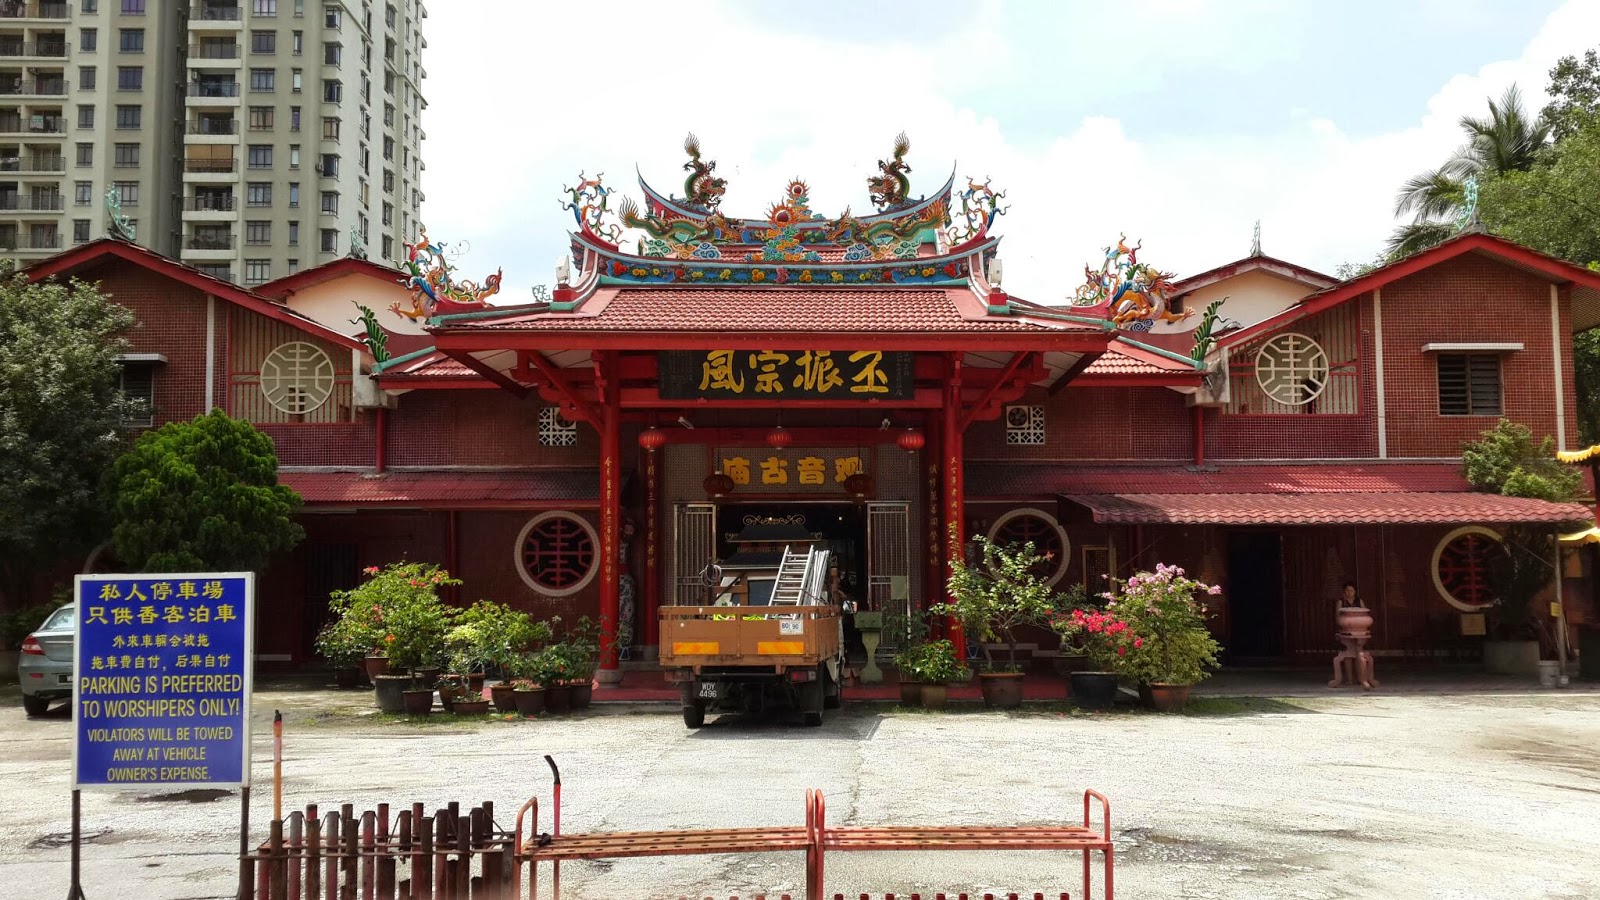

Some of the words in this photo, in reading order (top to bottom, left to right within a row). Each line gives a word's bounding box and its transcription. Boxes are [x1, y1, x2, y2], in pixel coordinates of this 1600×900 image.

[98, 580, 224, 601] 私人停車場
[85, 603, 237, 625] 只供香客泊車
[80, 675, 141, 695] PARKING
[145, 676, 158, 694] IS
[162, 674, 242, 693] PREFERRED
[701, 682, 716, 690] WDY
[699, 690, 717, 698] 4496
[82, 700, 100, 718] TO
[104, 699, 195, 718] WORSHIPERS
[199, 698, 240, 716] ONLY!
[87, 728, 144, 742] VIOLATORS
[148, 728, 173, 741] WILL
[176, 727, 190, 740] BE
[194, 726, 233, 740] TOWED
[113, 748, 144, 761] AWAY
[146, 747, 160, 761] AT
[163, 747, 206, 760] VEHICLE
[106, 767, 157, 781] OWNER'S
[160, 767, 212, 780] EXPENSE.
